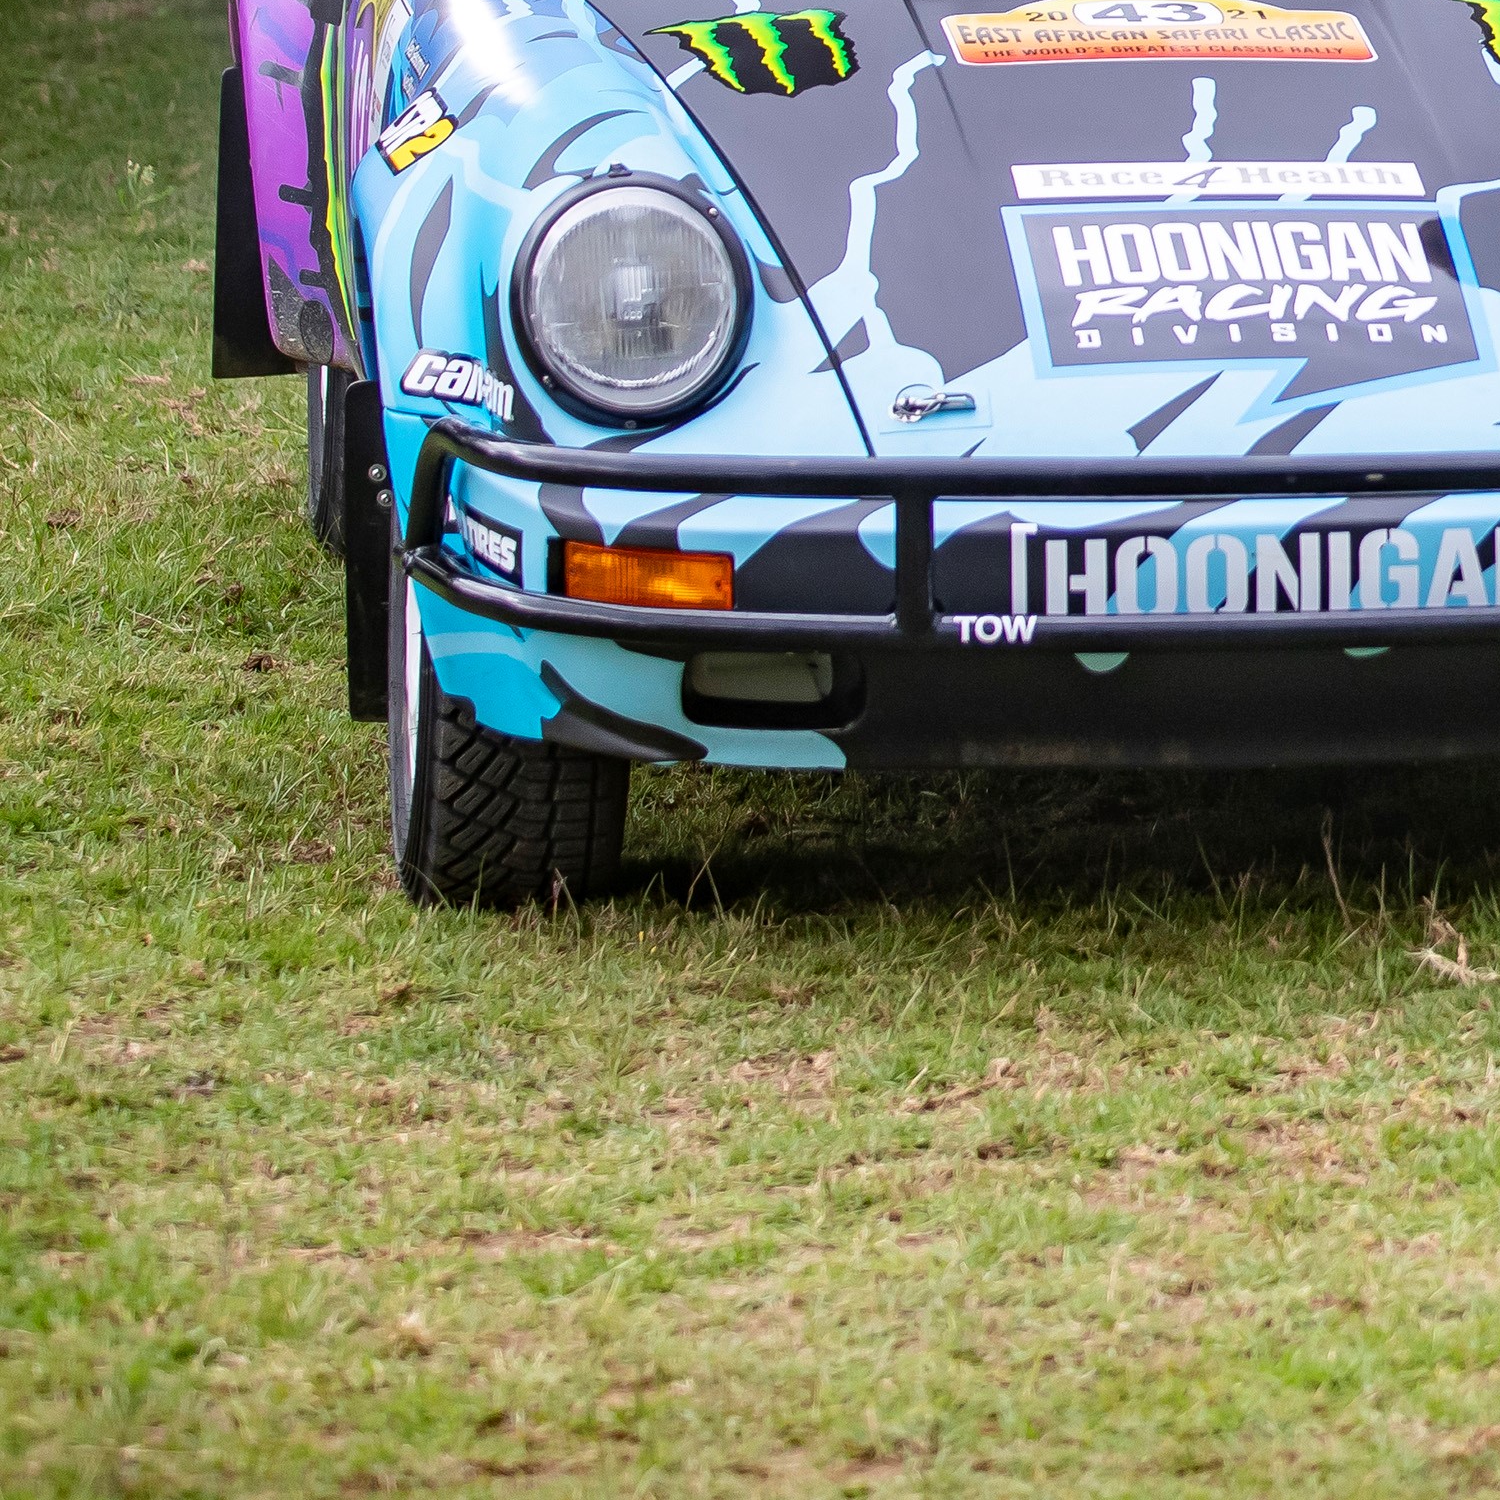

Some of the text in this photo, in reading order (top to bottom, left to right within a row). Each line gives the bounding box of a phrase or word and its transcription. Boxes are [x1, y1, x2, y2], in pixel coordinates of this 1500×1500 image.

[1025, 3, 1267, 22] 20 43 21
[958, 21, 1354, 45] EAST AFRICAN SAFARI CLASSIC
[981, 45, 1343, 58] THE WORLD'S GREATEST CLASSIC RALLY
[1040, 166, 1404, 189] Race 4 Health
[1051, 221, 1433, 287] HOONIGAN
[1072, 283, 1440, 328] RACING
[1075, 322, 1448, 349] DIVISION
[953, 615, 1038, 643] TOW
